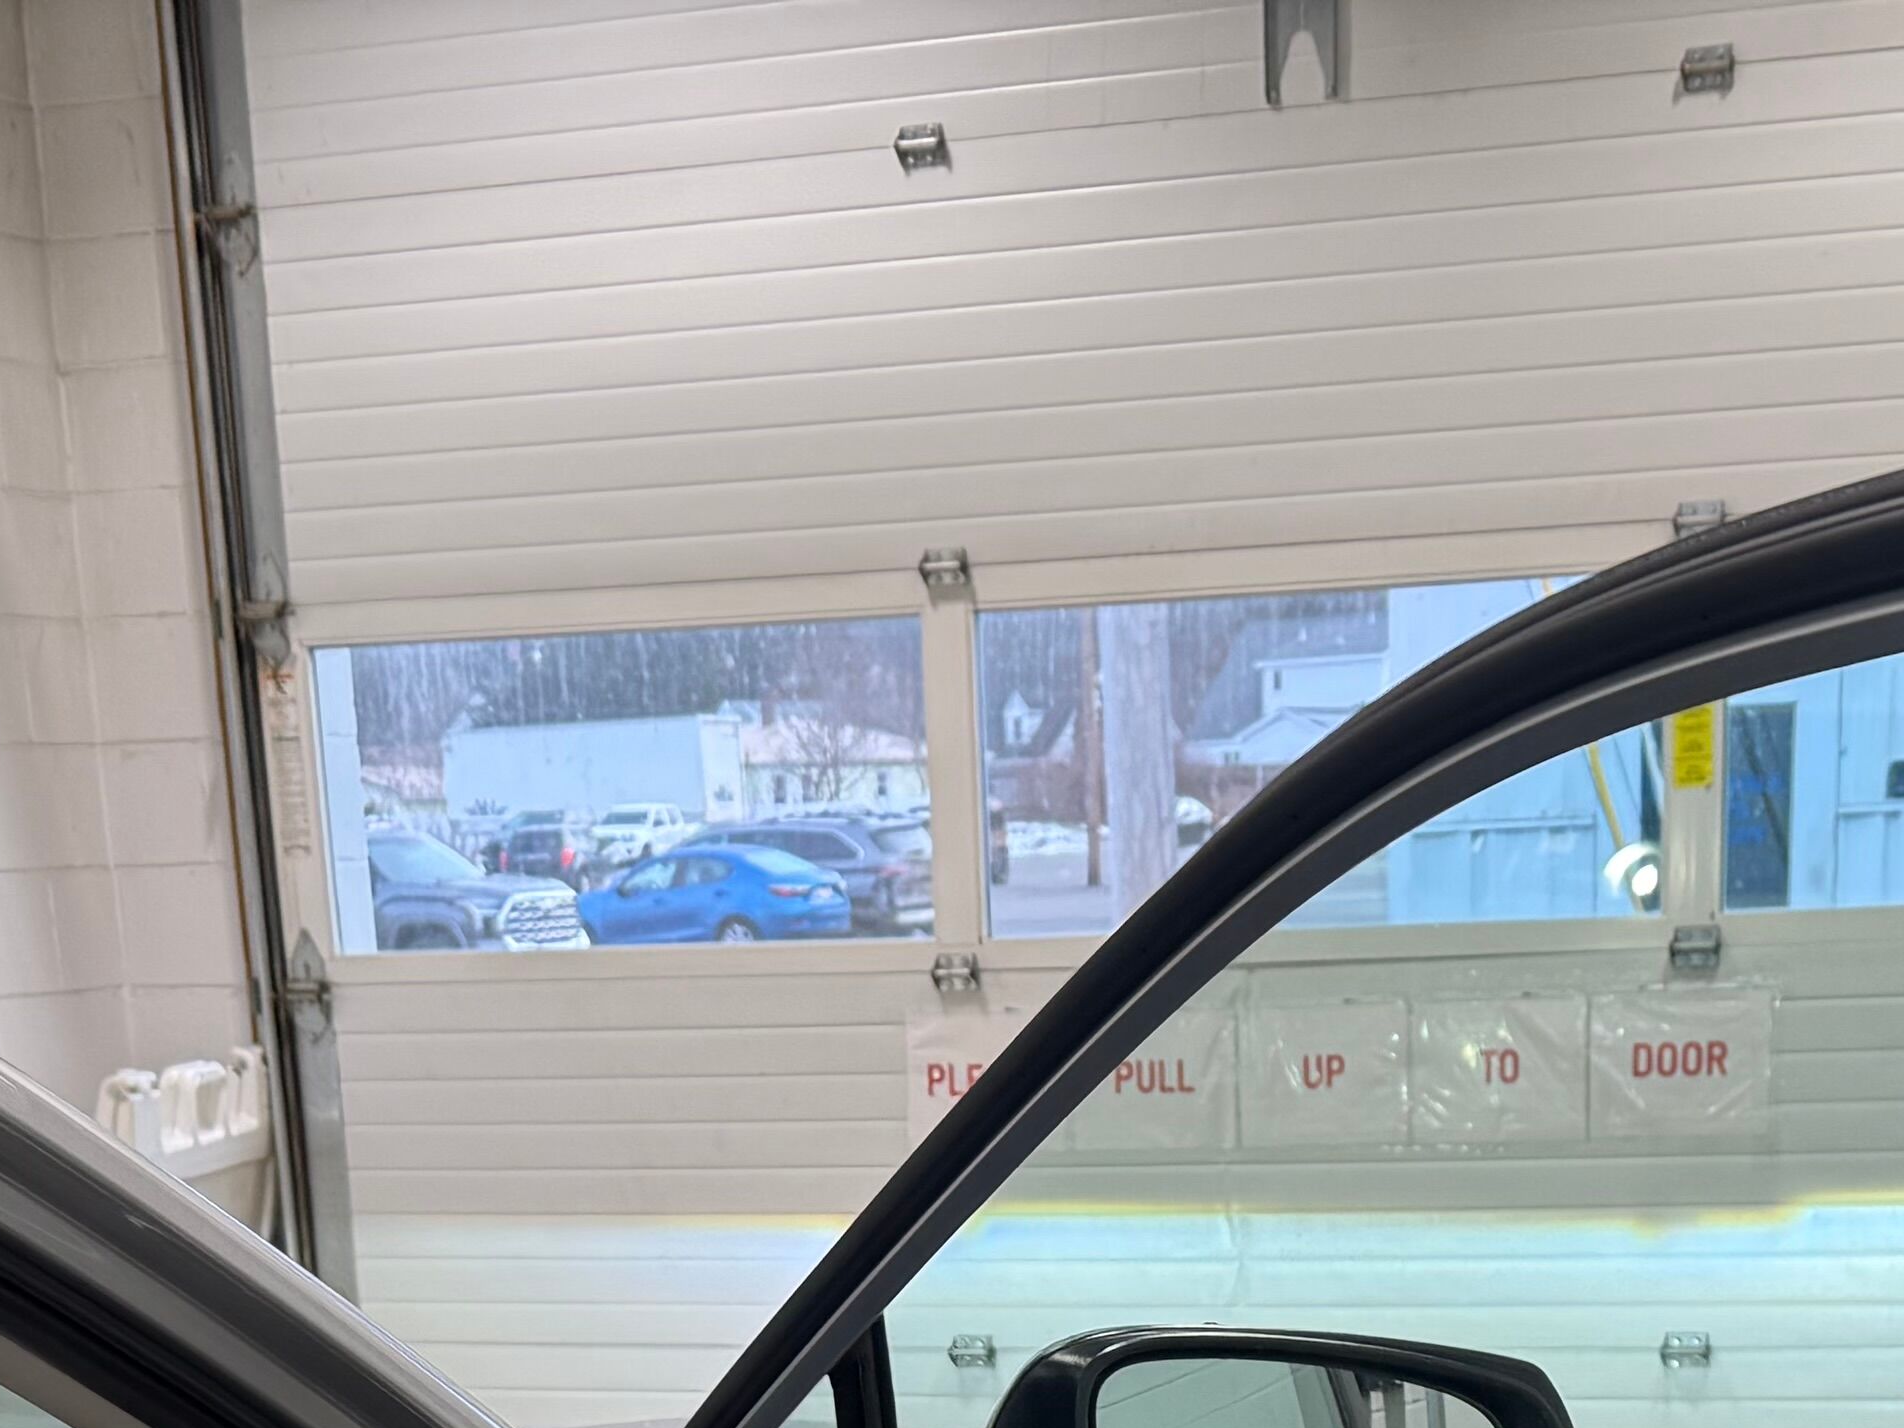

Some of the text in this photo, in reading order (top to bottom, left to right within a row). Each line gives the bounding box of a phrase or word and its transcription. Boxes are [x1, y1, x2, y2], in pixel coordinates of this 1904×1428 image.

[1114, 1058, 1195, 1094] PULL
[1302, 1054, 1346, 1089] UP
[1480, 1048, 1521, 1085] TO
[1631, 1040, 1728, 1078] DOOR
